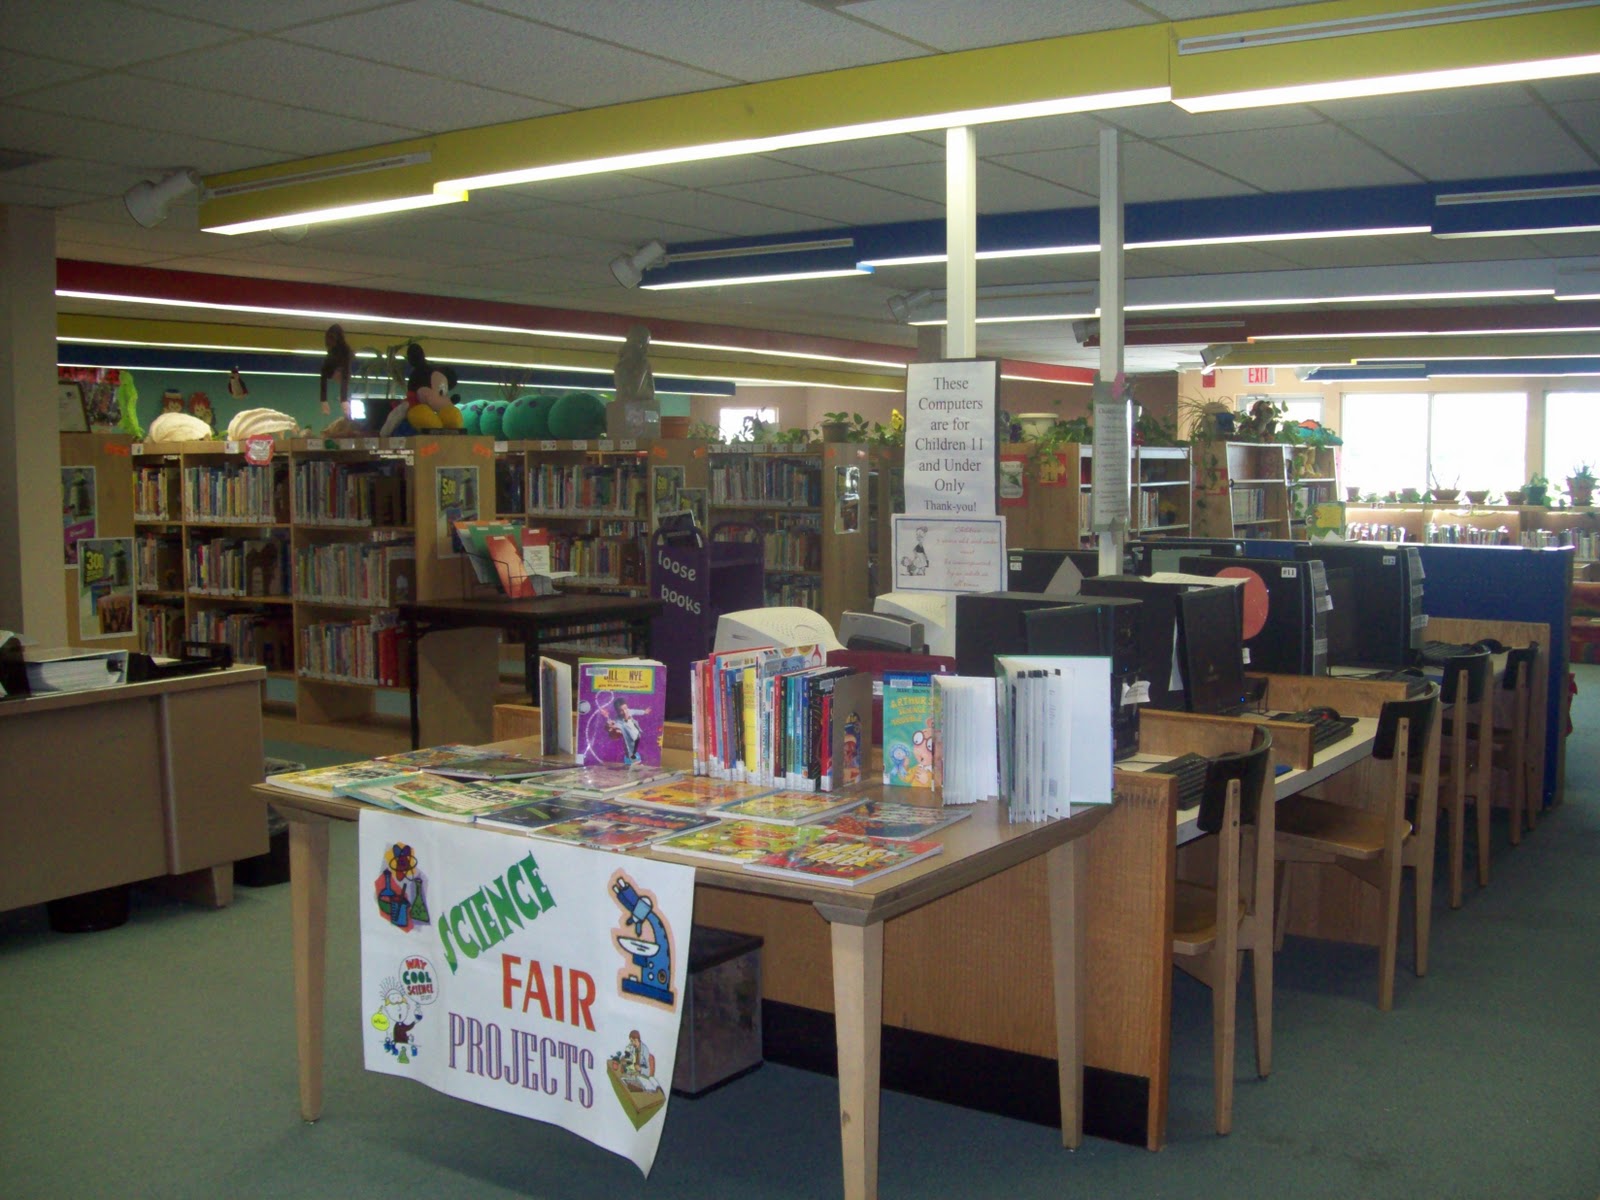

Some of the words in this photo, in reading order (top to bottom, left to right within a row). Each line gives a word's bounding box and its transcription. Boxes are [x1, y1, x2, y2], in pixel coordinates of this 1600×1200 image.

[1248, 367, 1268, 383] EXIT
[933, 377, 969, 390] These
[918, 397, 983, 413] Computers
[930, 421, 949, 431] are
[953, 417, 970, 431] for
[915, 437, 966, 451] Children
[971, 437, 983, 451] 11
[918, 458, 940, 471] and
[944, 458, 981, 471] Under
[934, 478, 965, 495] Only
[924, 500, 977, 514] Thank-you!
[658, 549, 697, 581] loose
[661, 584, 701, 615] books
[629, 670, 643, 681] NYE
[438, 850, 557, 976] SCIENCE
[405, 958, 428, 970] WAY
[402, 970, 432, 985] COOL
[407, 983, 434, 995] SCIENCE
[502, 953, 596, 1033] FAIR
[448, 1011, 594, 1109] PROJECTS
